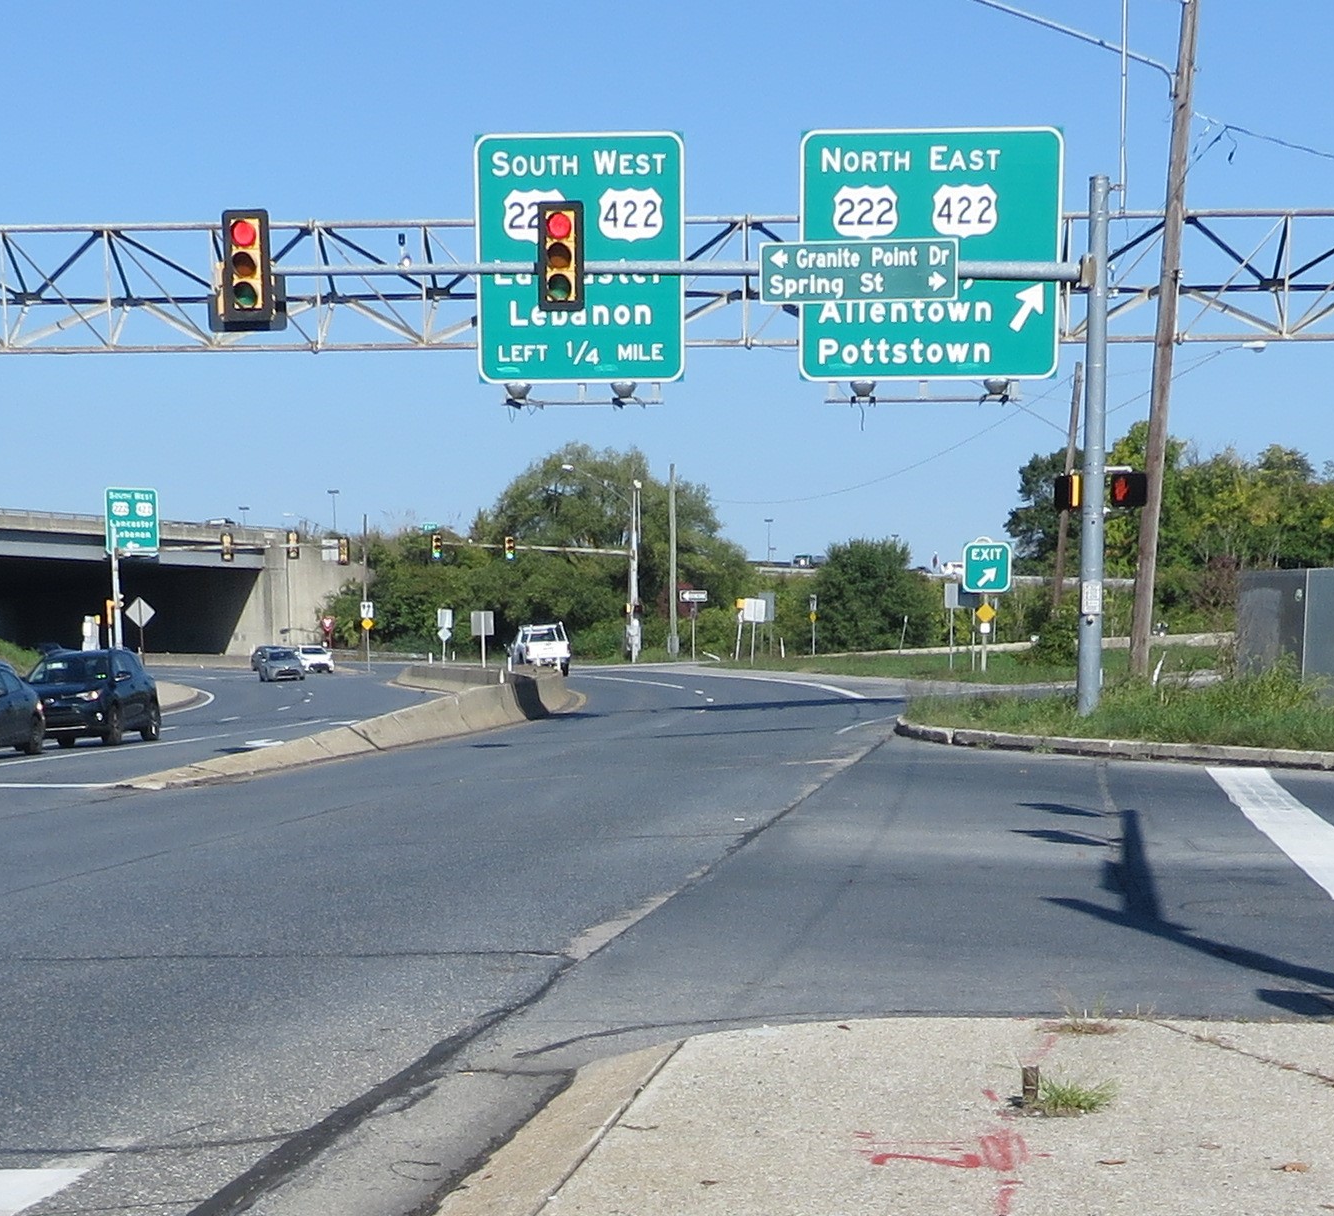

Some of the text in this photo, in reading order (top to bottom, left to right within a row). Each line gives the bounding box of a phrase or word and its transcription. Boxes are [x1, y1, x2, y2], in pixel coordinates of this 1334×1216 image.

[492, 150, 666, 177] SOUTH WEST
[821, 146, 1001, 172] NORTH EAST
[508, 200, 657, 229] 22 422
[838, 197, 992, 225] 222 422
[796, 246, 949, 268] Granite Point Dr
[770, 273, 884, 297] Spring St
[818, 302, 992, 323] Allentown
[498, 345, 548, 362] LEFT
[618, 344, 664, 361] MILE
[818, 338, 991, 364] Pottstown
[971, 548, 1003, 560] EXIT
